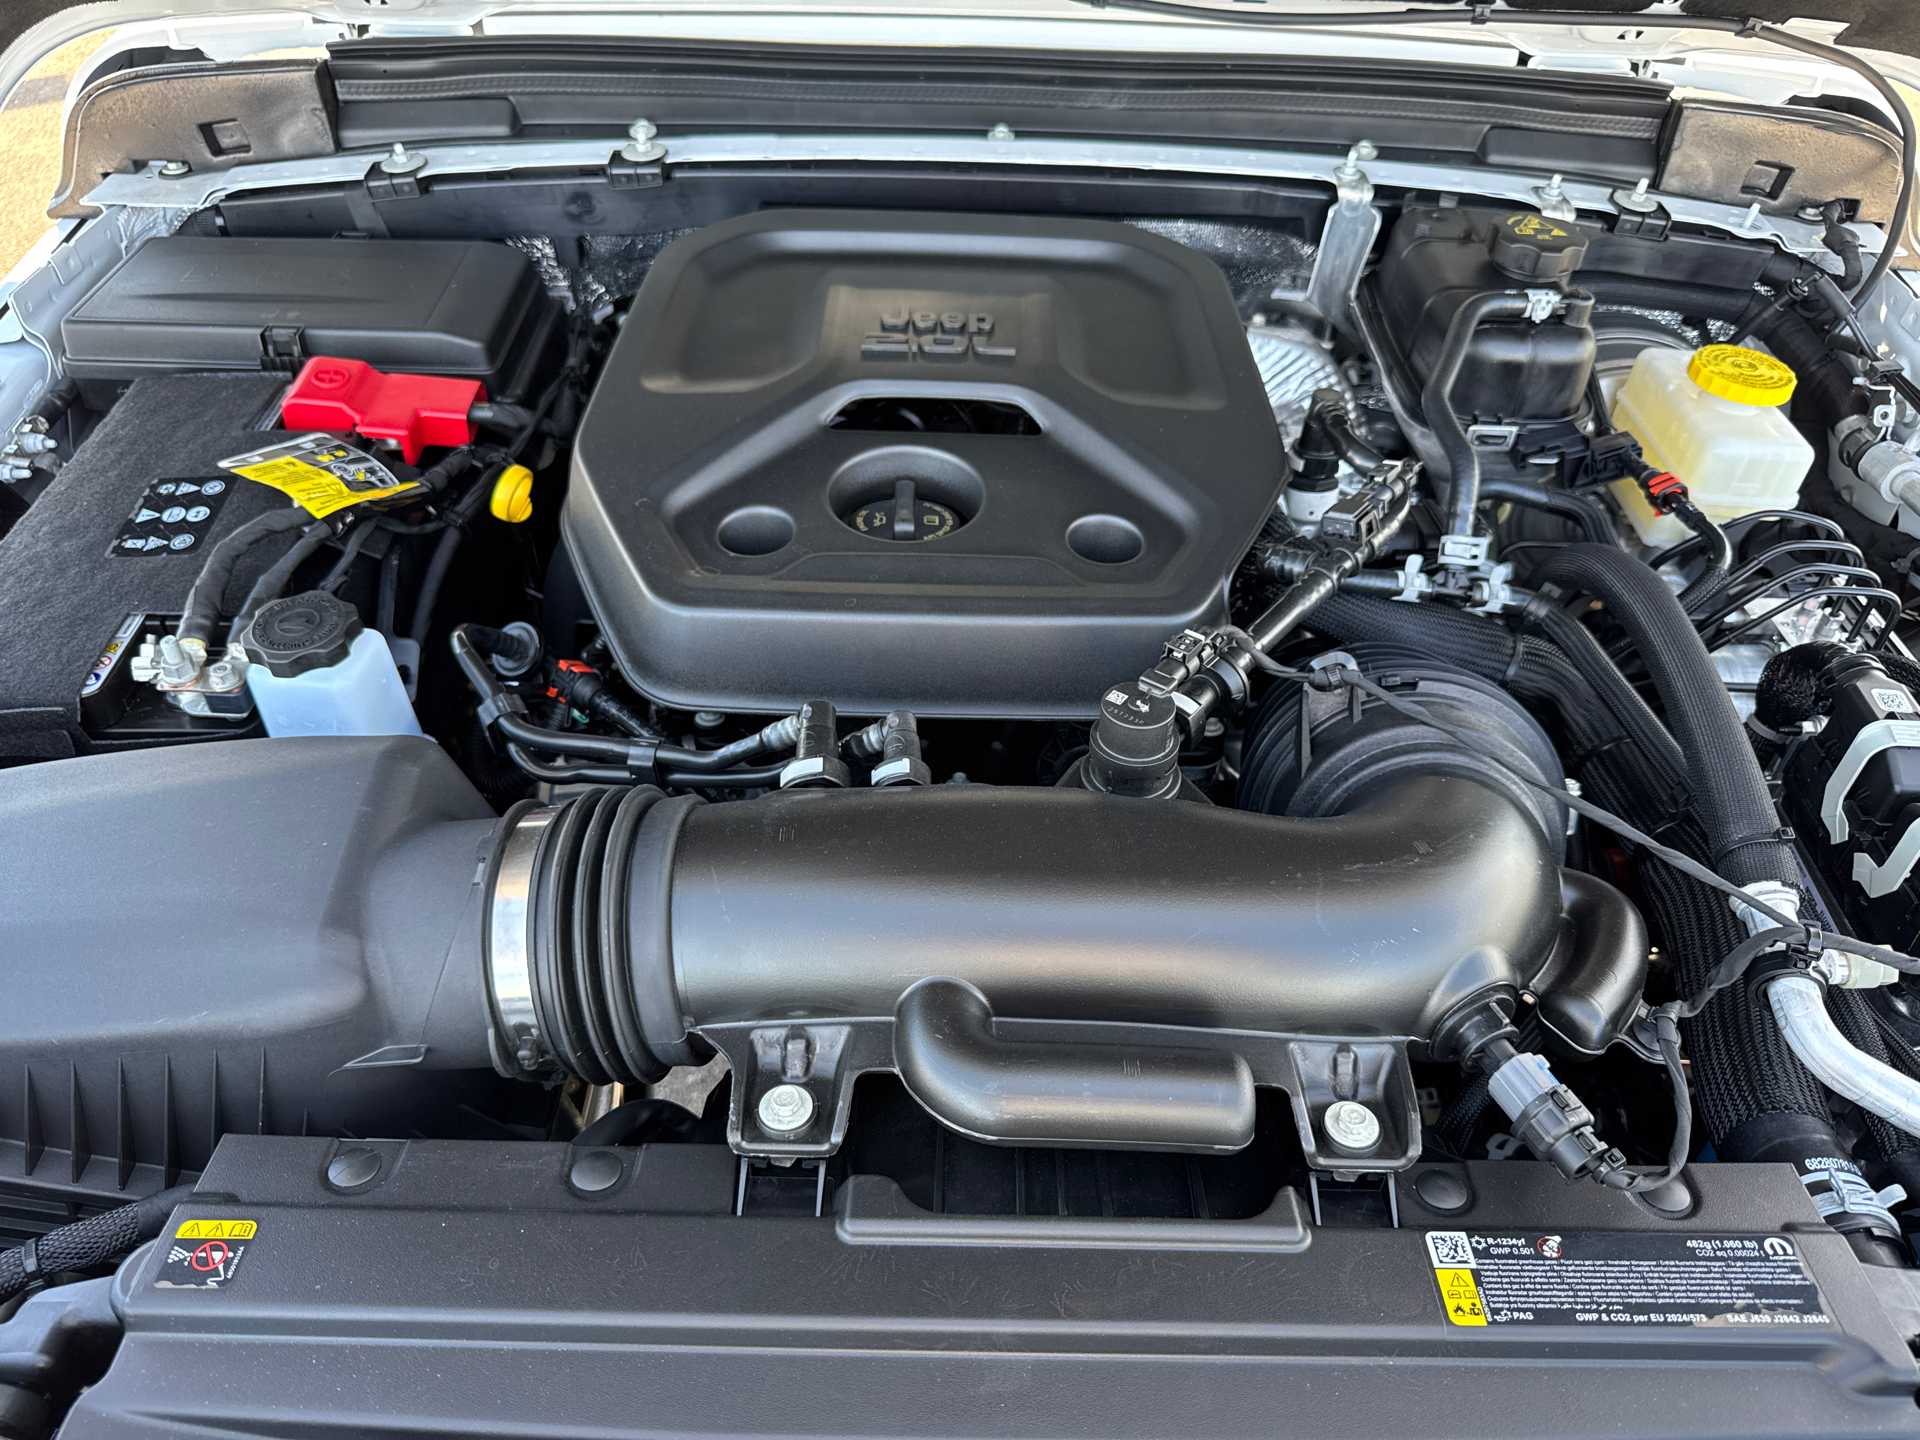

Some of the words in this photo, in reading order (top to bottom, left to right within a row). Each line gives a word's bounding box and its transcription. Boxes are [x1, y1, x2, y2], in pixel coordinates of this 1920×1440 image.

[881, 306, 995, 333] Jeep
[861, 333, 1017, 357] 2.0L
[1686, 1240, 1711, 1250] 482g
[1712, 1240, 1742, 1249] (1.060
[1744, 1240, 1759, 1250] lb)
[1696, 1249, 1715, 1257] CO2
[1512, 1312, 1534, 1320] PAG
[1576, 1312, 1599, 1321] GWP
[1602, 1313, 1609, 1321] &
[1611, 1314, 1631, 1322] CO2
[1633, 1315, 1648, 1323] per
[1650, 1314, 1664, 1322] EU
[1727, 1315, 1748, 1323] SAE
